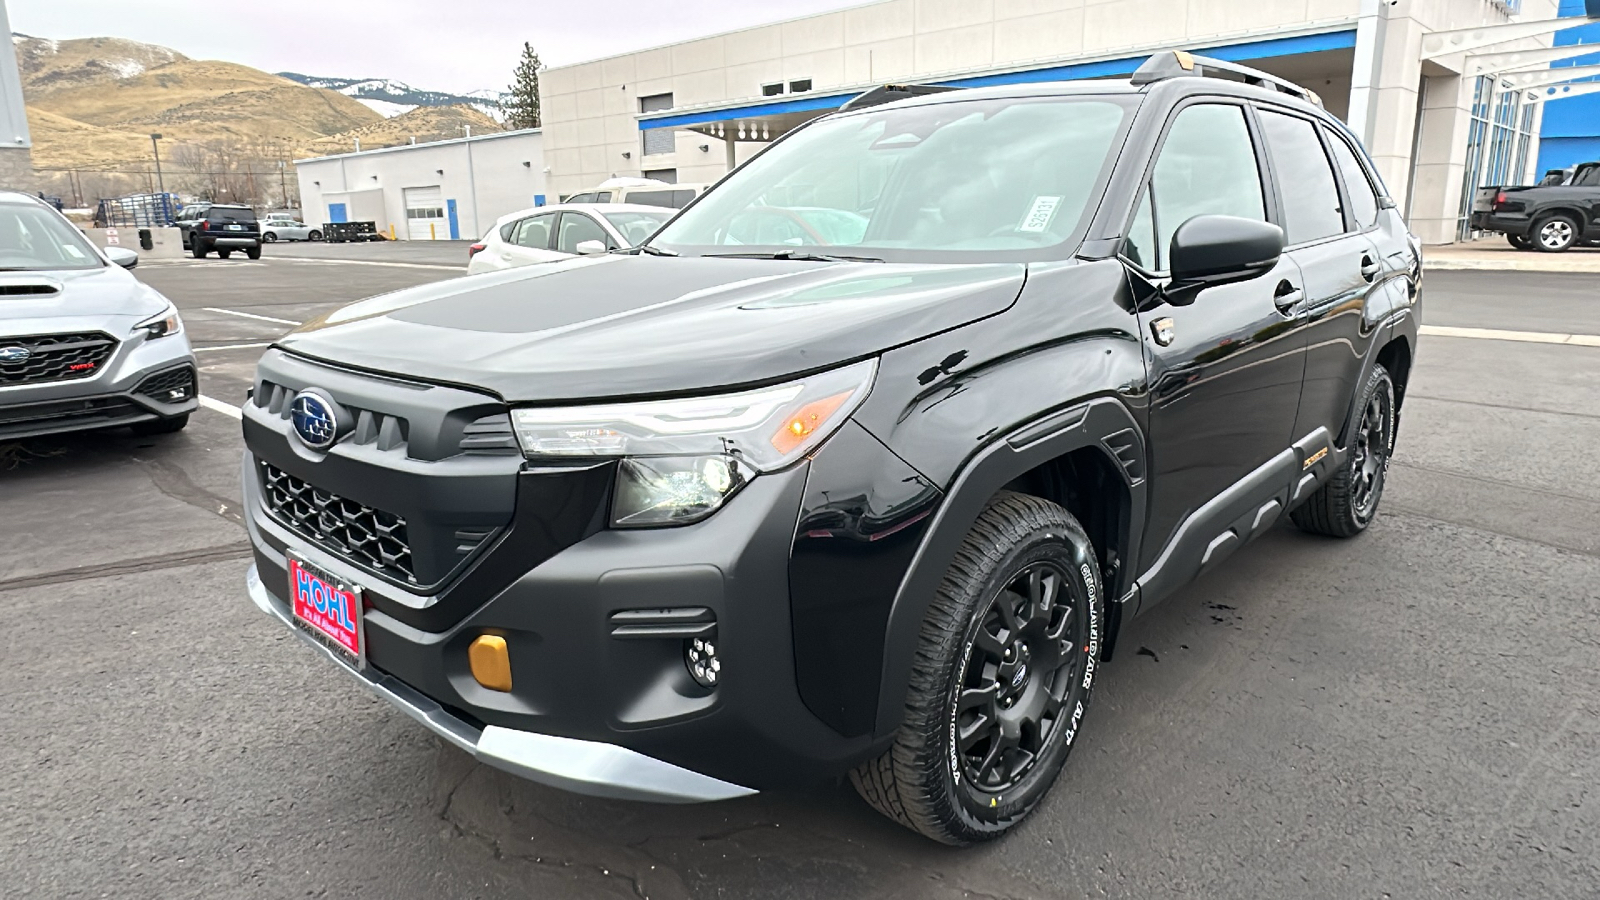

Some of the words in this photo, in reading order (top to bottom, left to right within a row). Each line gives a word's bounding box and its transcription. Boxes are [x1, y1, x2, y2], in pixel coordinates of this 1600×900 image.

[1027, 200, 1055, 228] S26131
[70, 362, 94, 370] WRX
[296, 568, 356, 634] HOHL
[1080, 563, 1098, 690] GEOLANDAR
